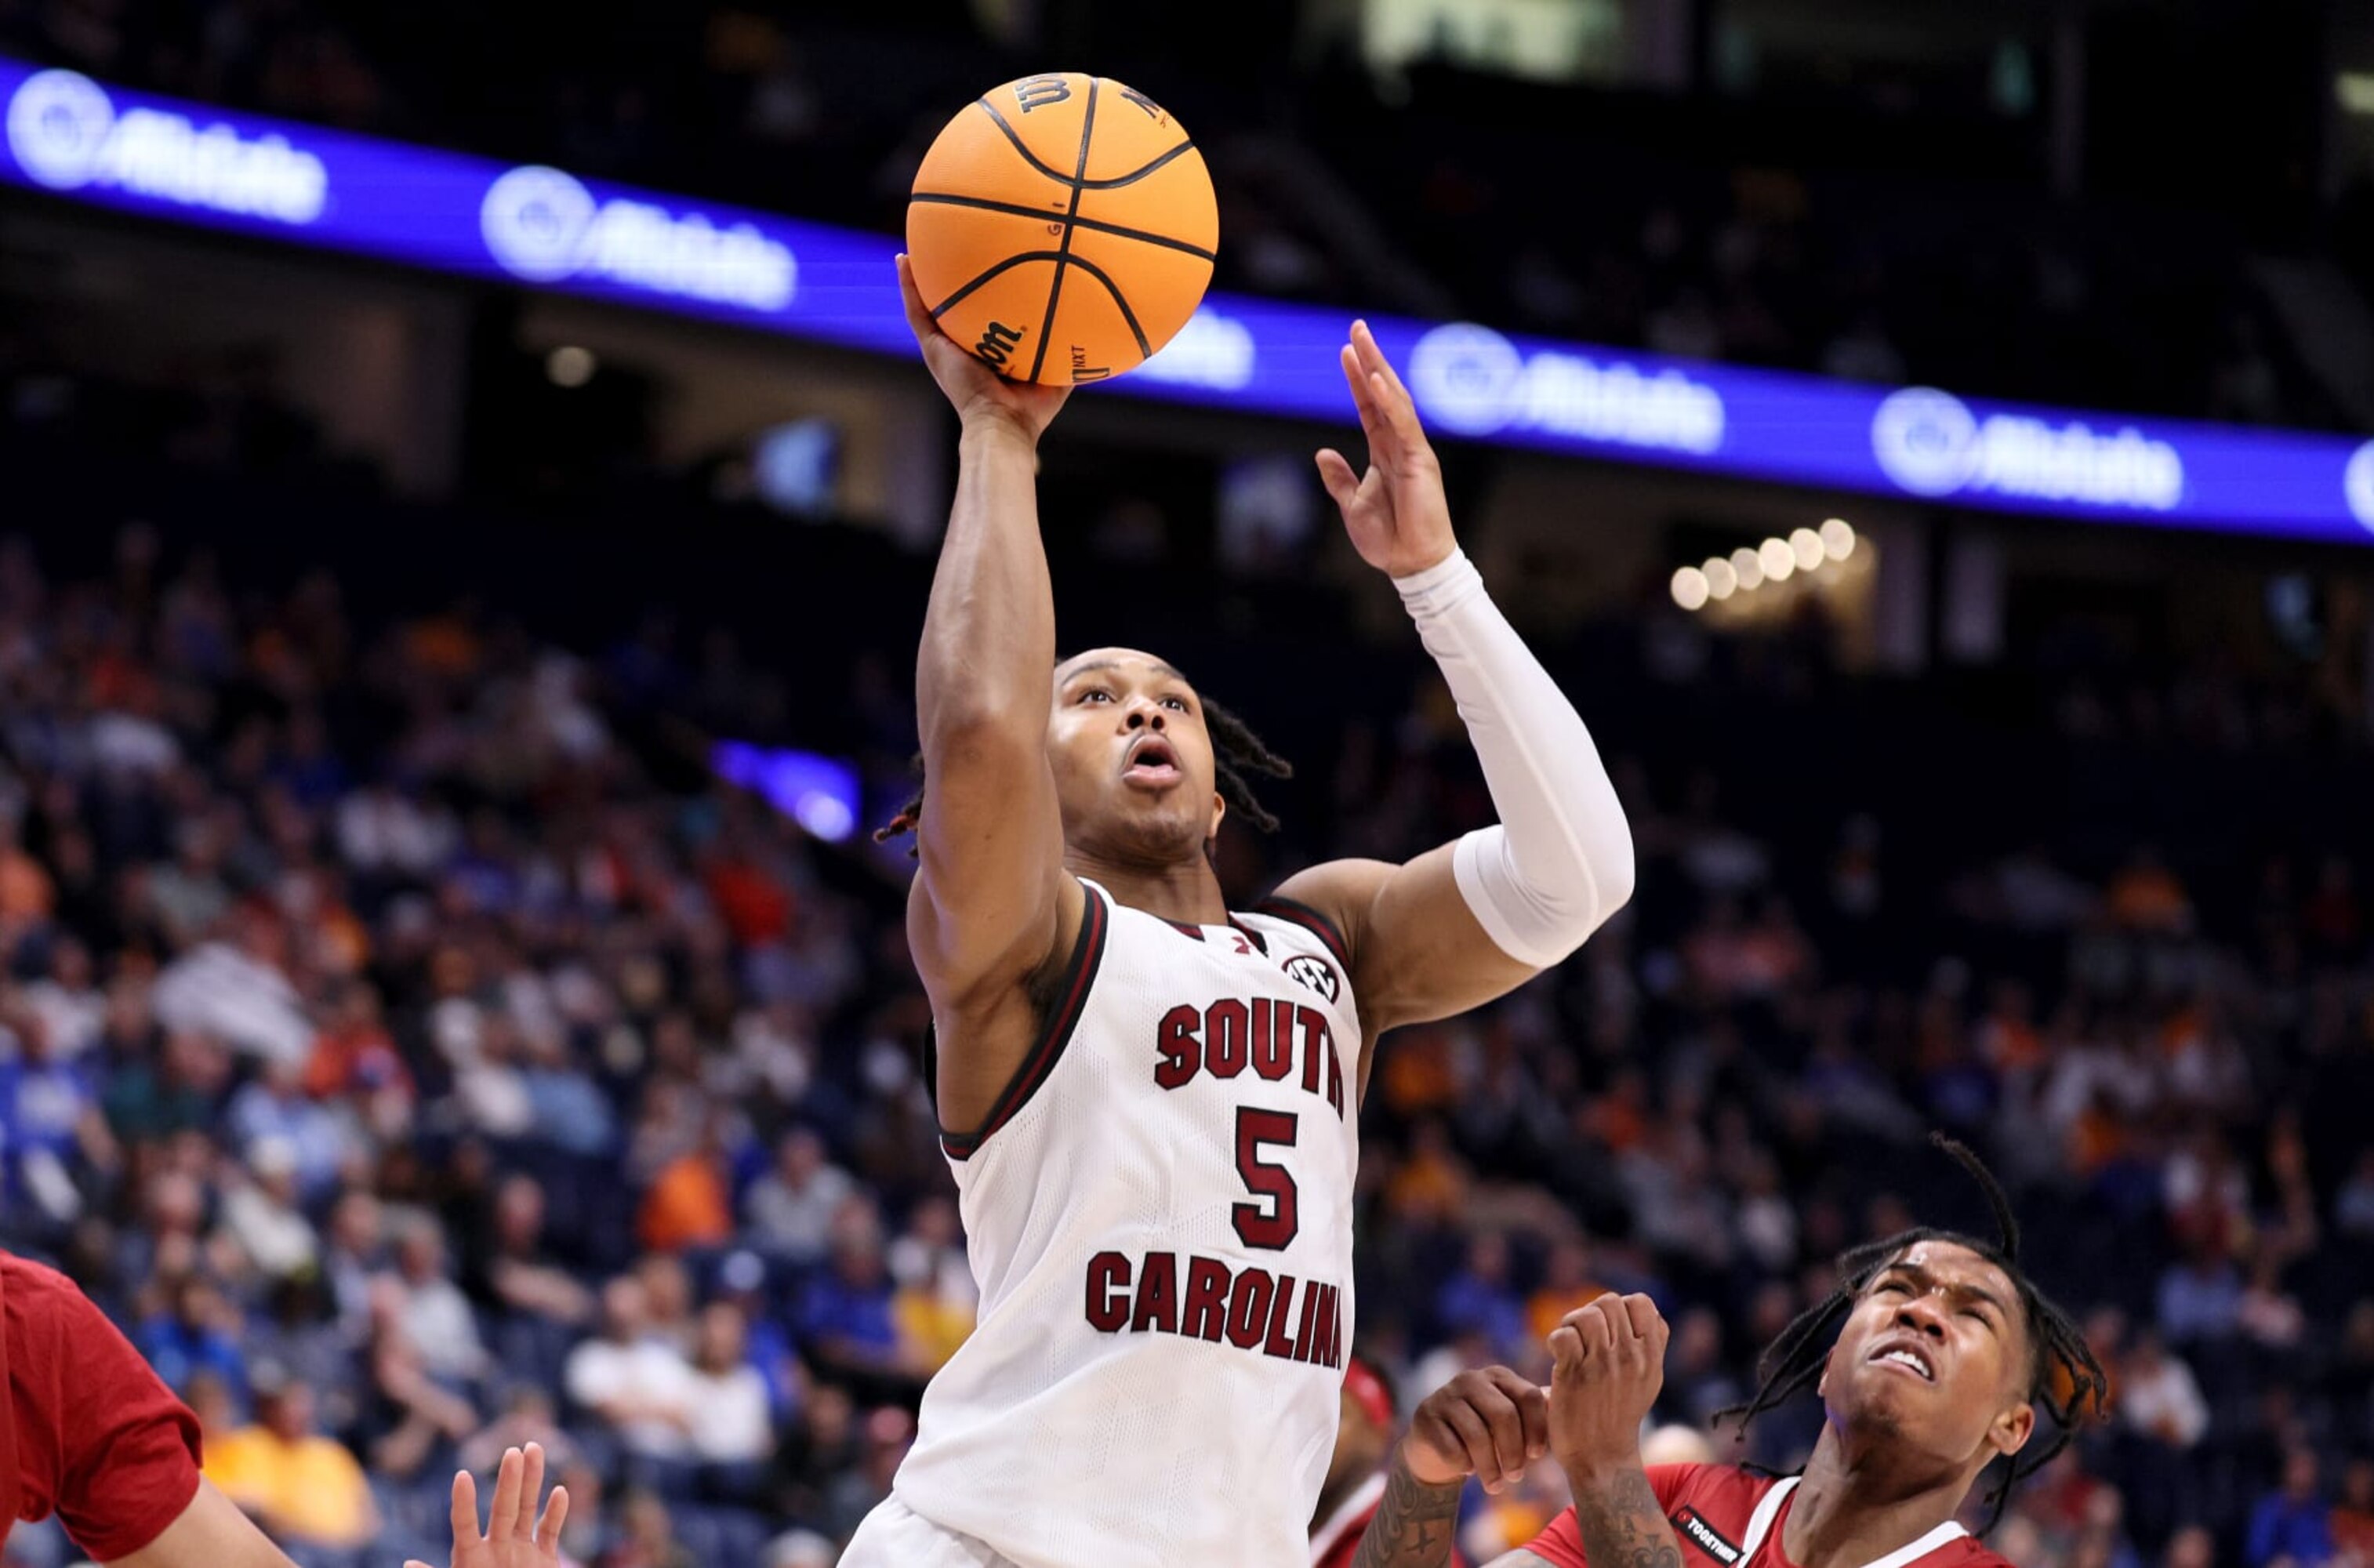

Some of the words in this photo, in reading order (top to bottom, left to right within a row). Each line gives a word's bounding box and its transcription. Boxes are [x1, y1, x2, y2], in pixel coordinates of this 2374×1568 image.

[1071, 345, 1086, 368] NXT
[1154, 997, 1344, 1123] SOUTH
[1231, 1105, 1298, 1251] 5
[1688, 1517, 1738, 1563] TOGETHER
